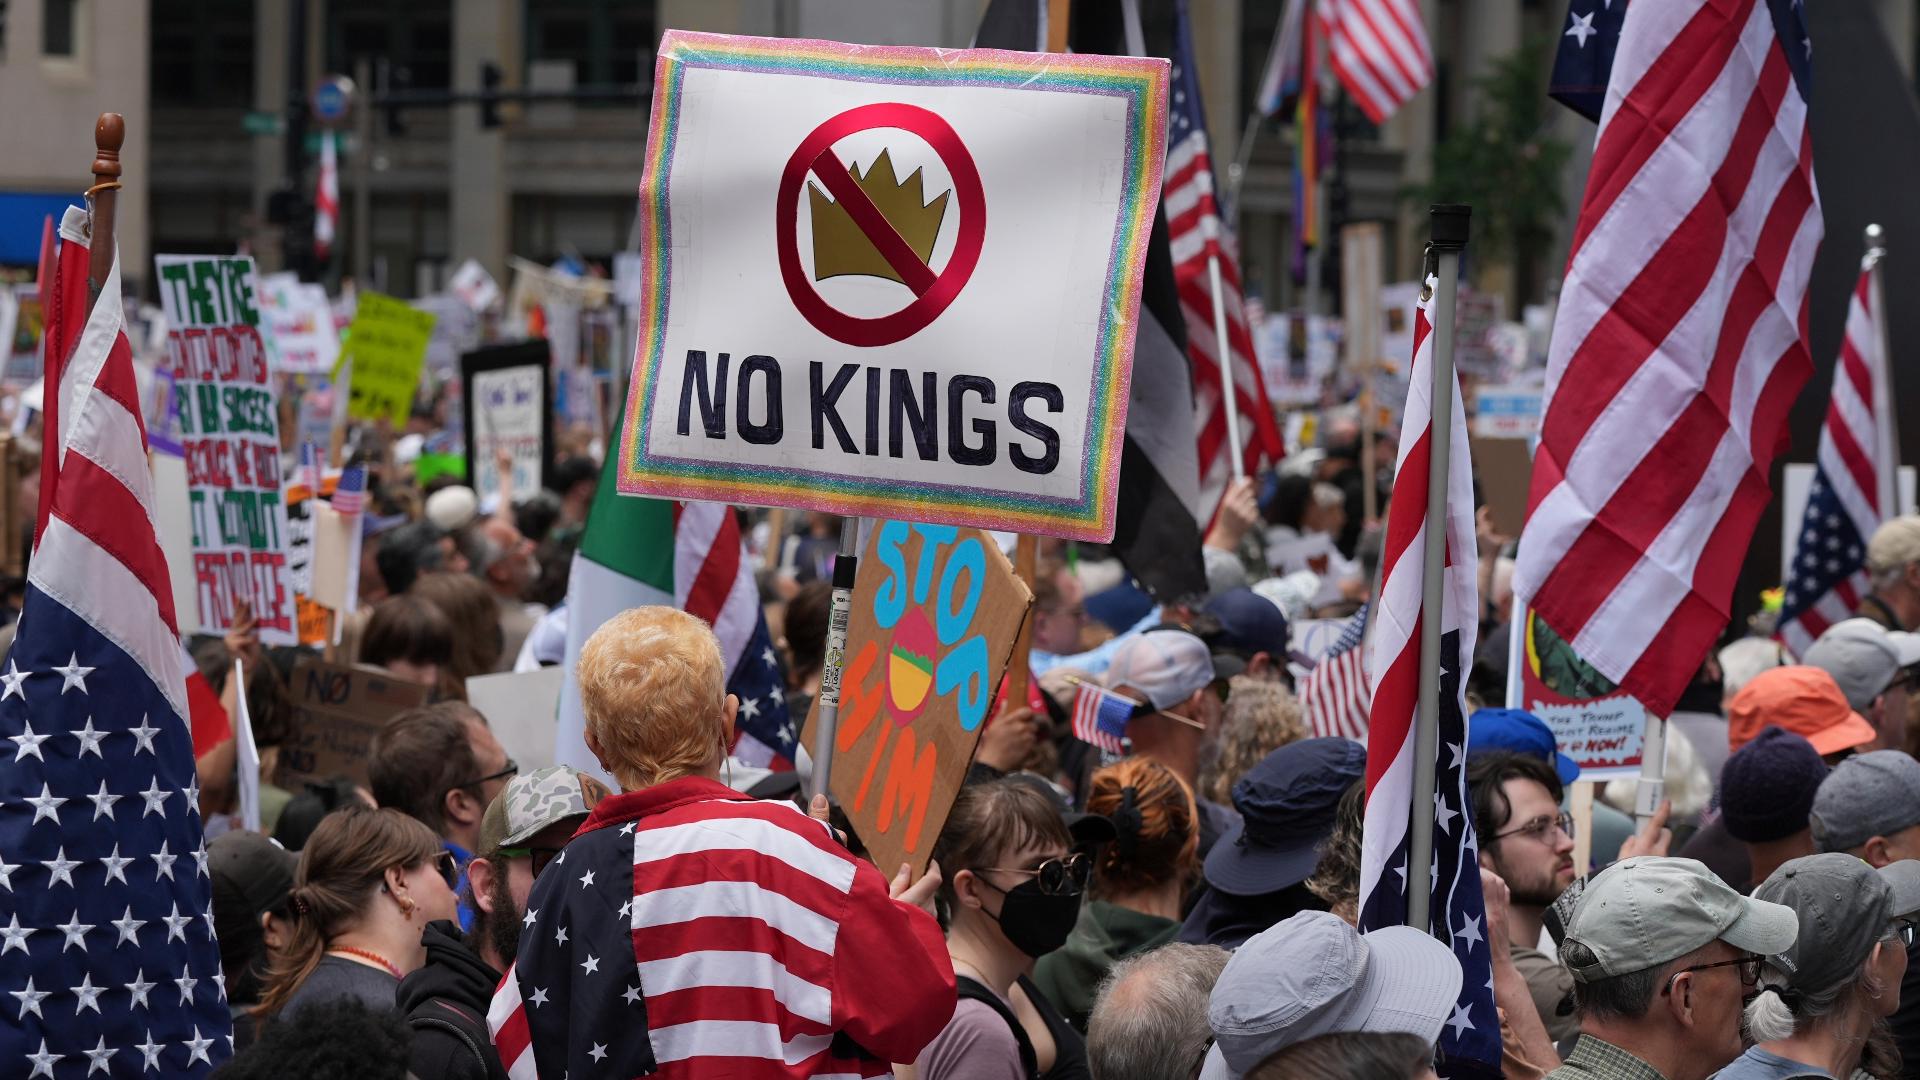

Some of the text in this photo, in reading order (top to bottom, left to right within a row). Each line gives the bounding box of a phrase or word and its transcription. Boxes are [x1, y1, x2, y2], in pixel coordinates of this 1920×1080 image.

[676, 349, 1064, 475] NO KINGS
[873, 518, 989, 732] STOP
[837, 639, 937, 854] HIM
[1585, 736, 1627, 752] NOW!
